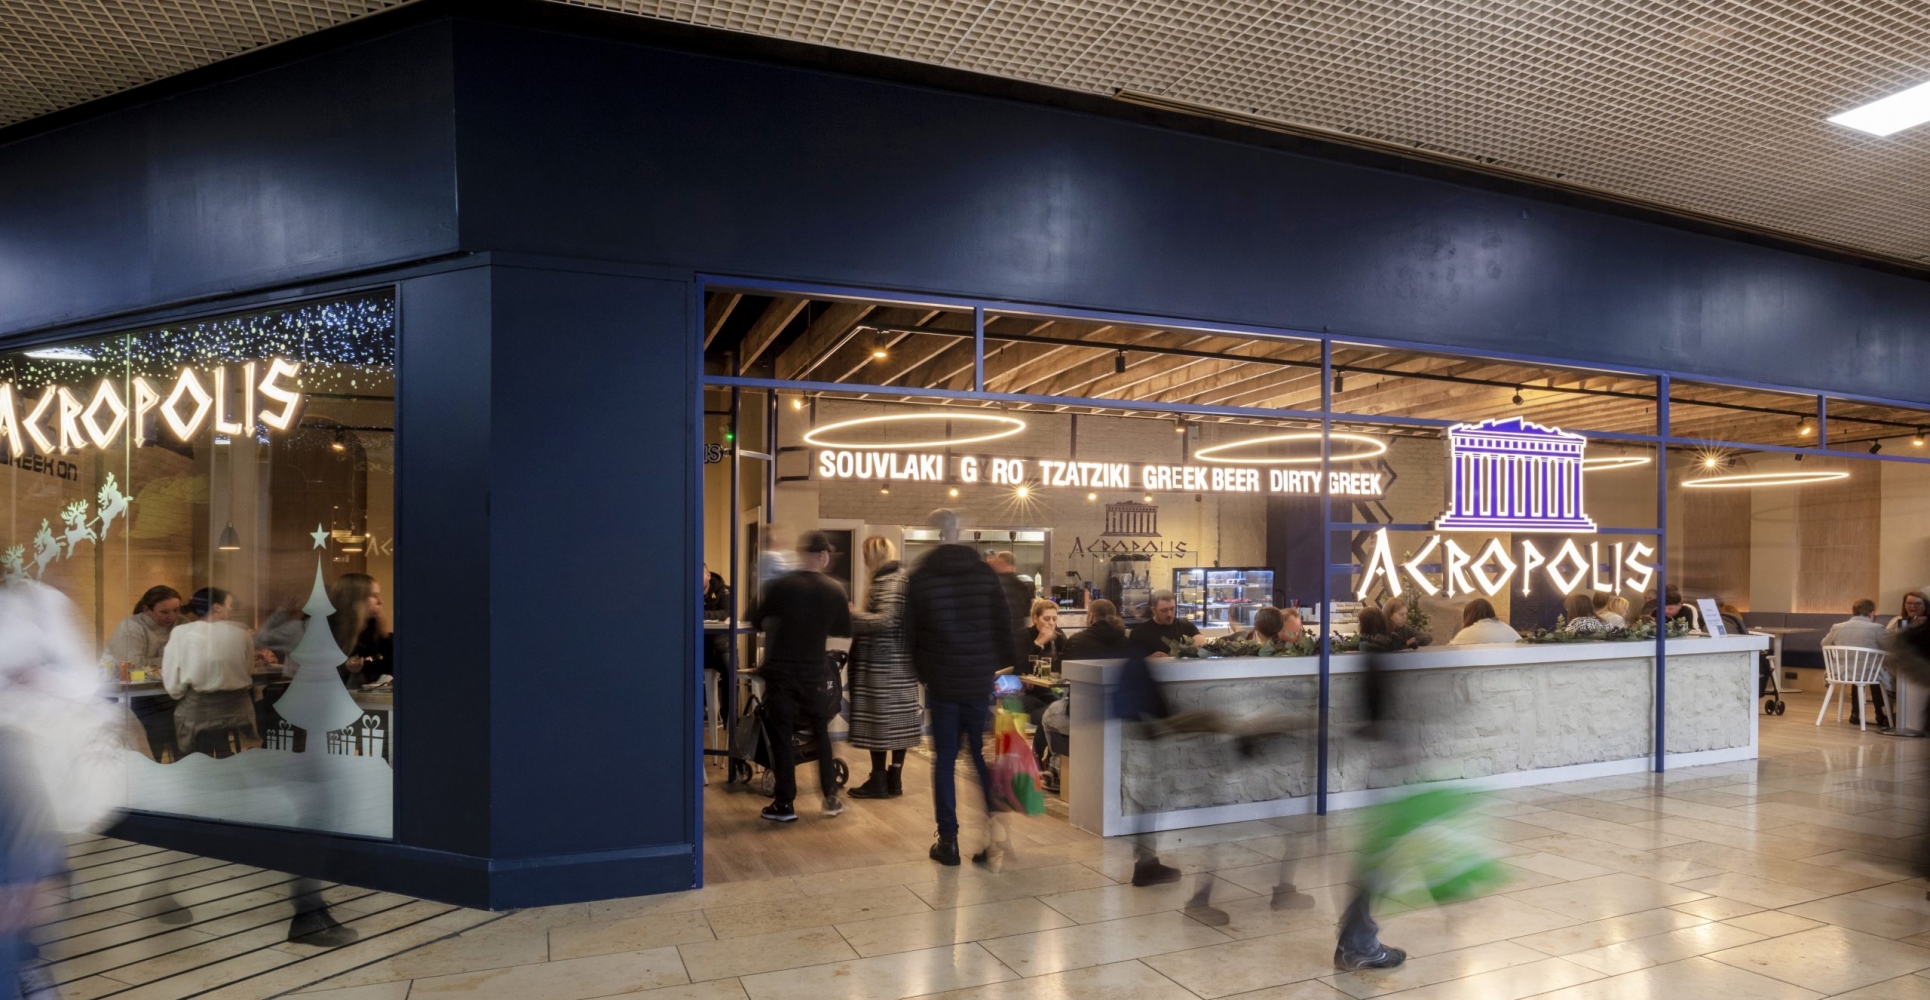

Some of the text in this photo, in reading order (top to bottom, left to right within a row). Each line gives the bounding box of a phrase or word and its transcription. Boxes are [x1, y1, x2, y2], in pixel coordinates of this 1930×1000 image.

[819, 450, 943, 481] SOUVLAKI
[1039, 460, 1130, 488] TZATZIKI
[1143, 466, 1208, 490] GREEK
[1212, 468, 1260, 492] BEER
[1270, 469, 1322, 493] DIRTY
[1329, 471, 1382, 495] GREEK
[1068, 536, 1187, 559] ACROPOLIS
[1356, 527, 1655, 602] ACROPOLIS
